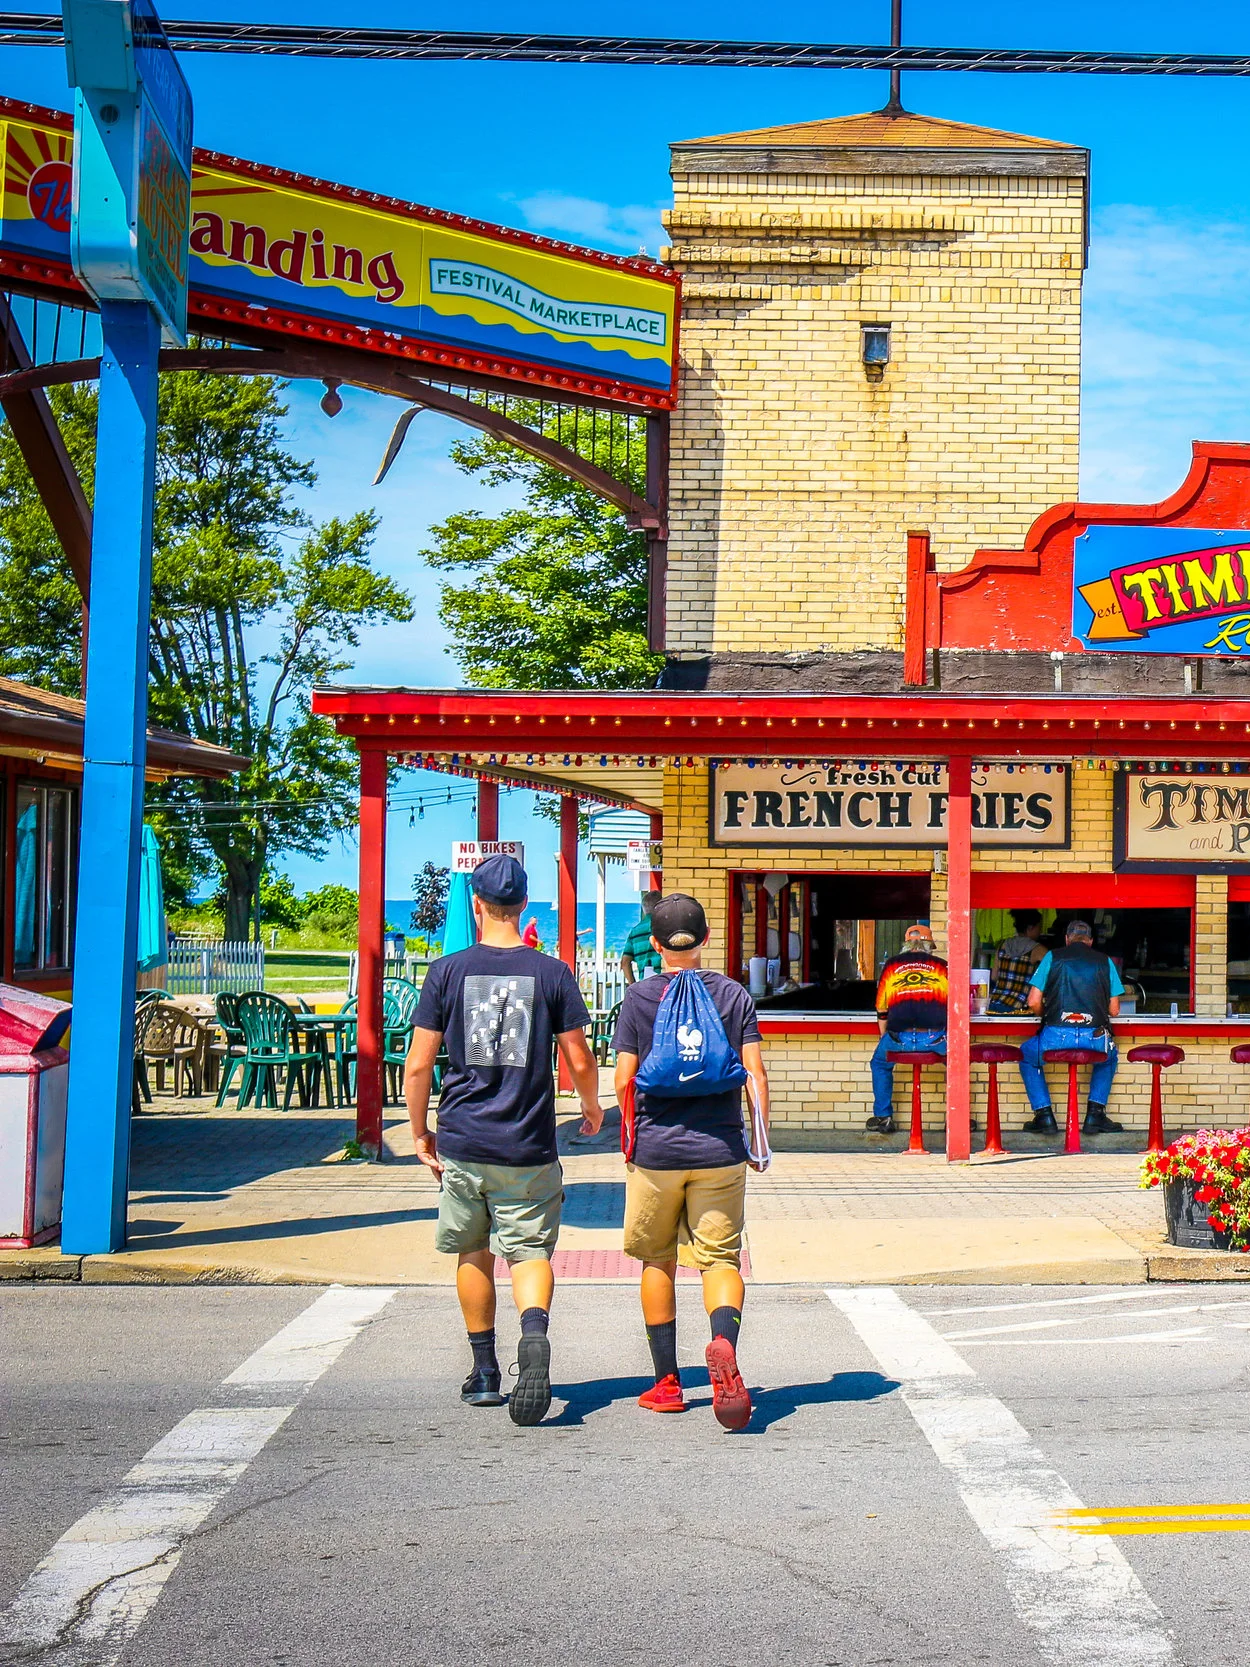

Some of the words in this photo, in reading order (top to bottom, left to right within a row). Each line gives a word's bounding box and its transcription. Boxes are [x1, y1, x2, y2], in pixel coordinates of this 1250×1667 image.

[33, 179, 72, 222] Th
[188, 210, 406, 304] anding
[138, 161, 185, 287] MOTEL
[436, 268, 526, 308] FESTIVAL
[529, 297, 660, 336] MARKETPLACE
[1097, 602, 1122, 618] est.
[723, 790, 913, 829] FRENCH
[459, 842, 475, 854] NO
[481, 842, 517, 854] BIKES
[1189, 828, 1224, 851] and
